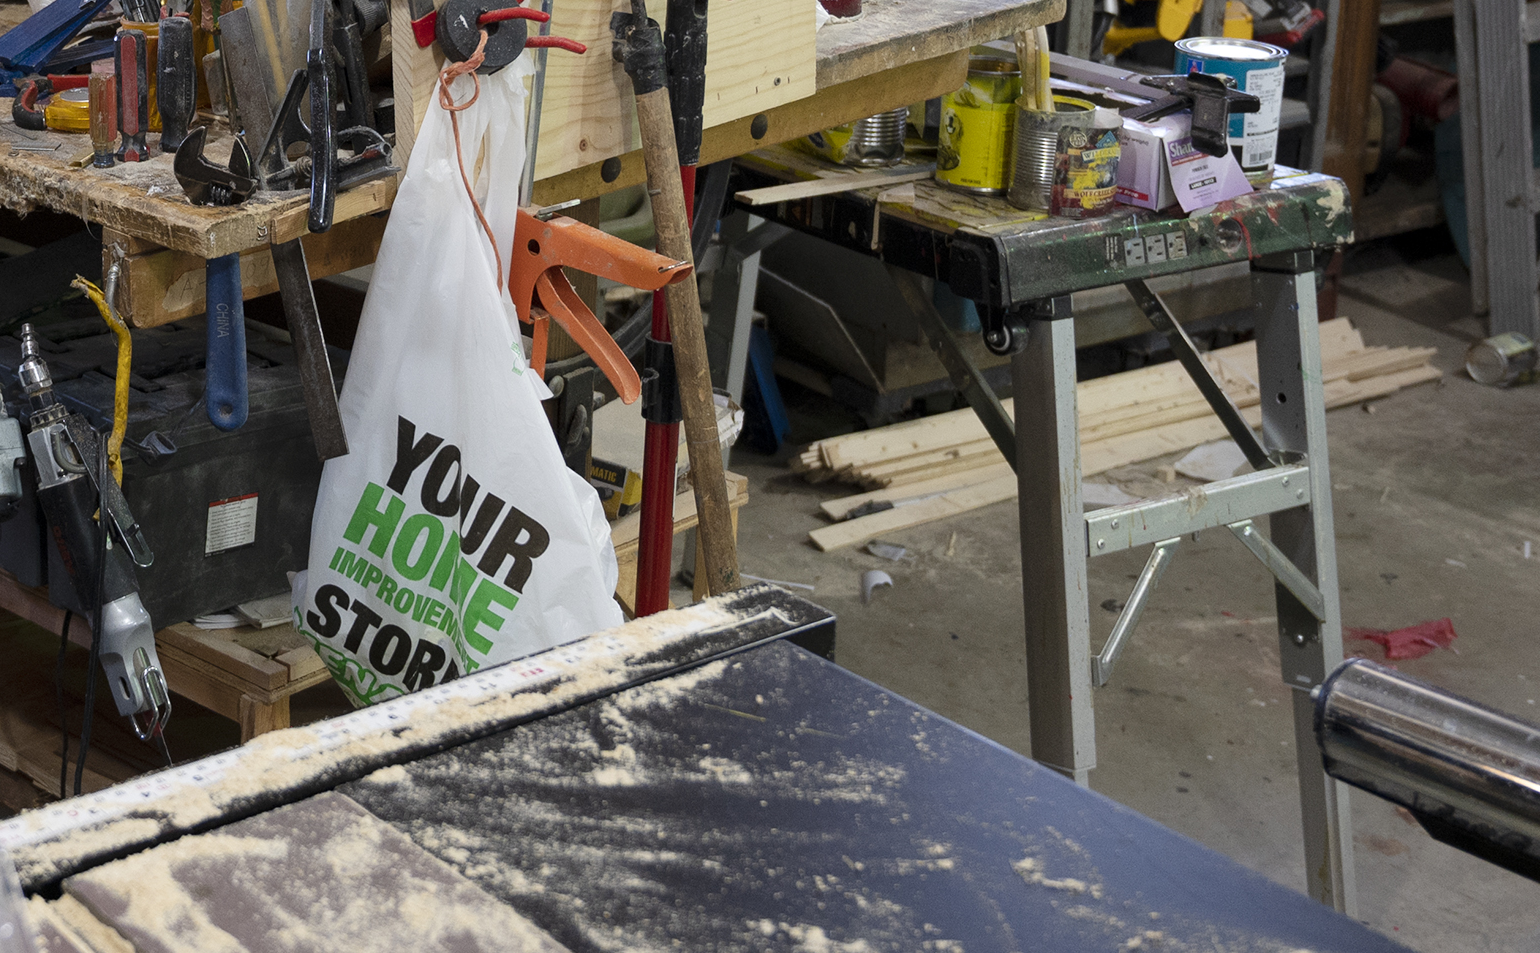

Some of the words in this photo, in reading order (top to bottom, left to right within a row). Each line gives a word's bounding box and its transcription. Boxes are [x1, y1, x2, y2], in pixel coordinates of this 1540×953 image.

[216, 302, 230, 339] CHINA
[386, 414, 551, 595] YOUR
[591, 467, 617, 483] MATIC
[342, 481, 520, 656] HOME
